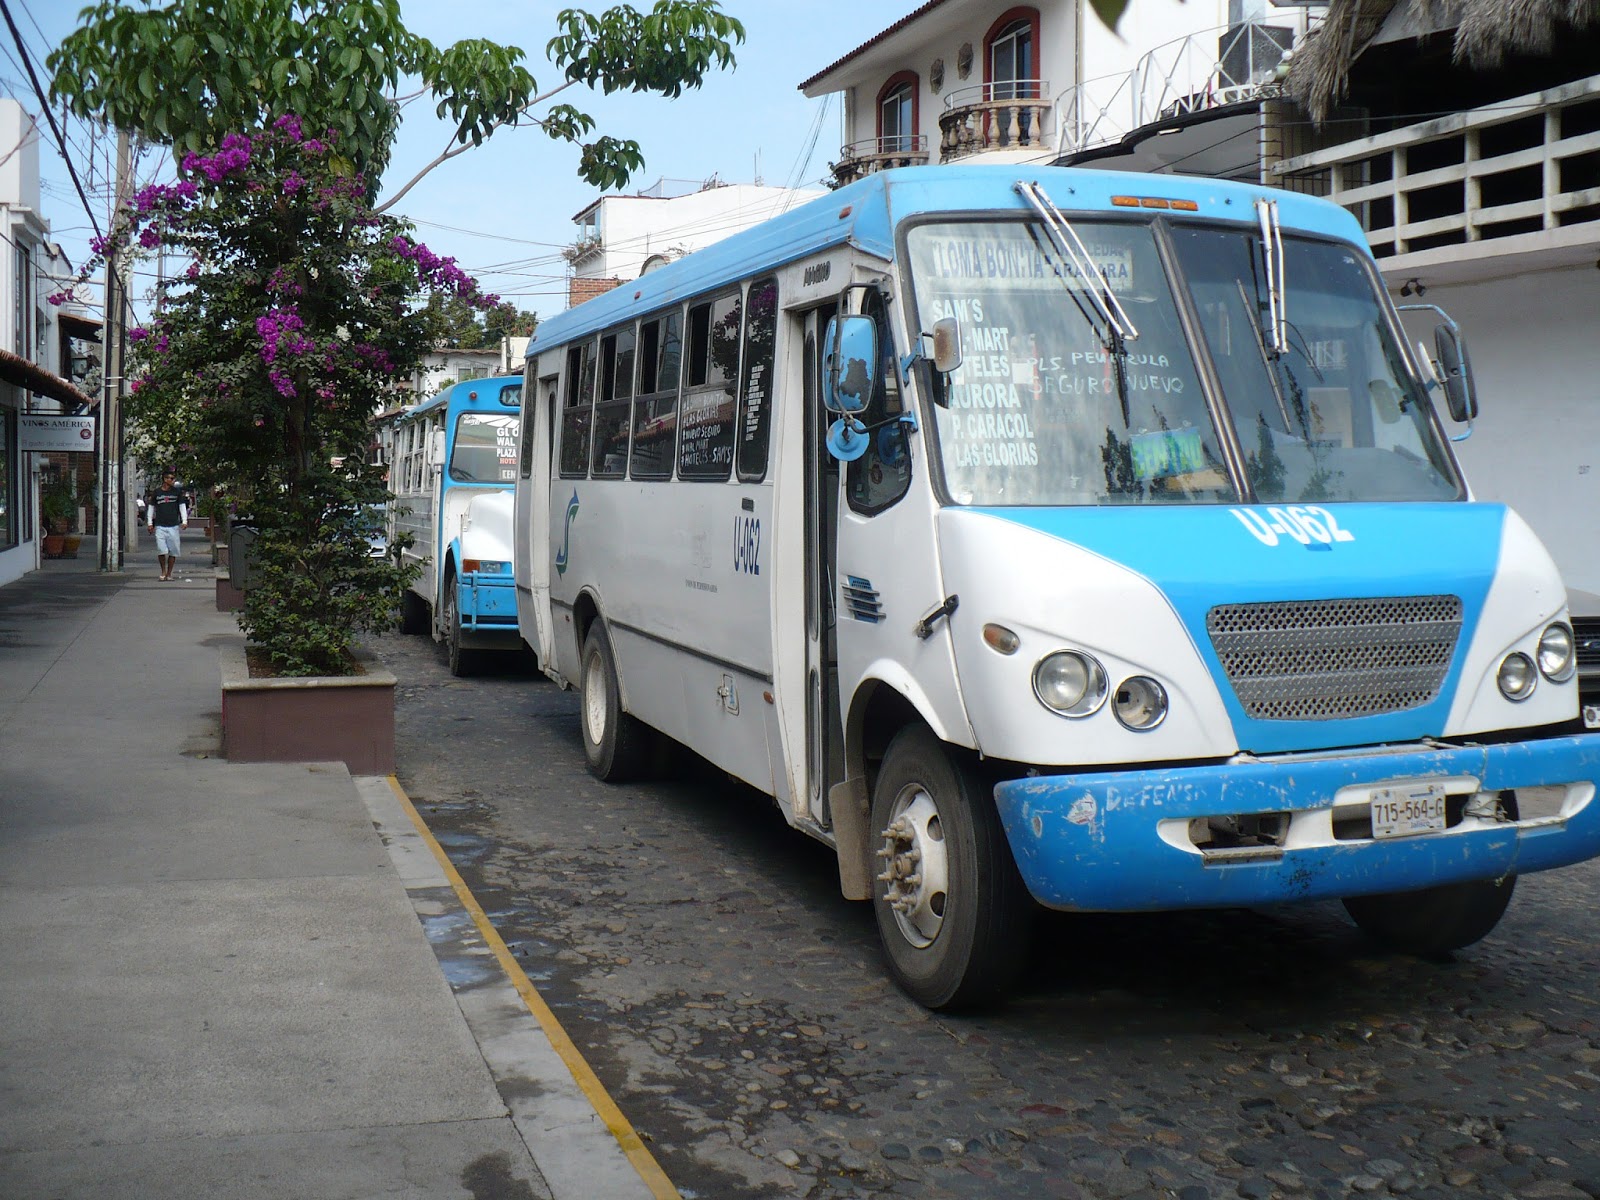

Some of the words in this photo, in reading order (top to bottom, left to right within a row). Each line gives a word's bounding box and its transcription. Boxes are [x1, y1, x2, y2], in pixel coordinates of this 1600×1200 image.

[939, 241, 983, 278] LOMA
[985, 240, 1043, 278] BONITA
[1053, 263, 1128, 278] ARAMARA
[962, 355, 1010, 377] TELES
[951, 383, 1021, 409] AURORA
[1028, 375, 1114, 395] SEGURO
[1127, 375, 1184, 394] NUEVO
[51, 418, 92, 428] AMÉRICA
[952, 414, 965, 439] P.
[967, 413, 1034, 438] CARACOL
[496, 437, 516, 447] WAL
[496, 448, 517, 458] PLAZA
[955, 443, 981, 467] LAS
[983, 442, 1039, 466] GLORIAS
[1228, 505, 1356, 547] U-062
[733, 515, 760, 576] U-062
[1374, 798, 1443, 824] 715-564-G
